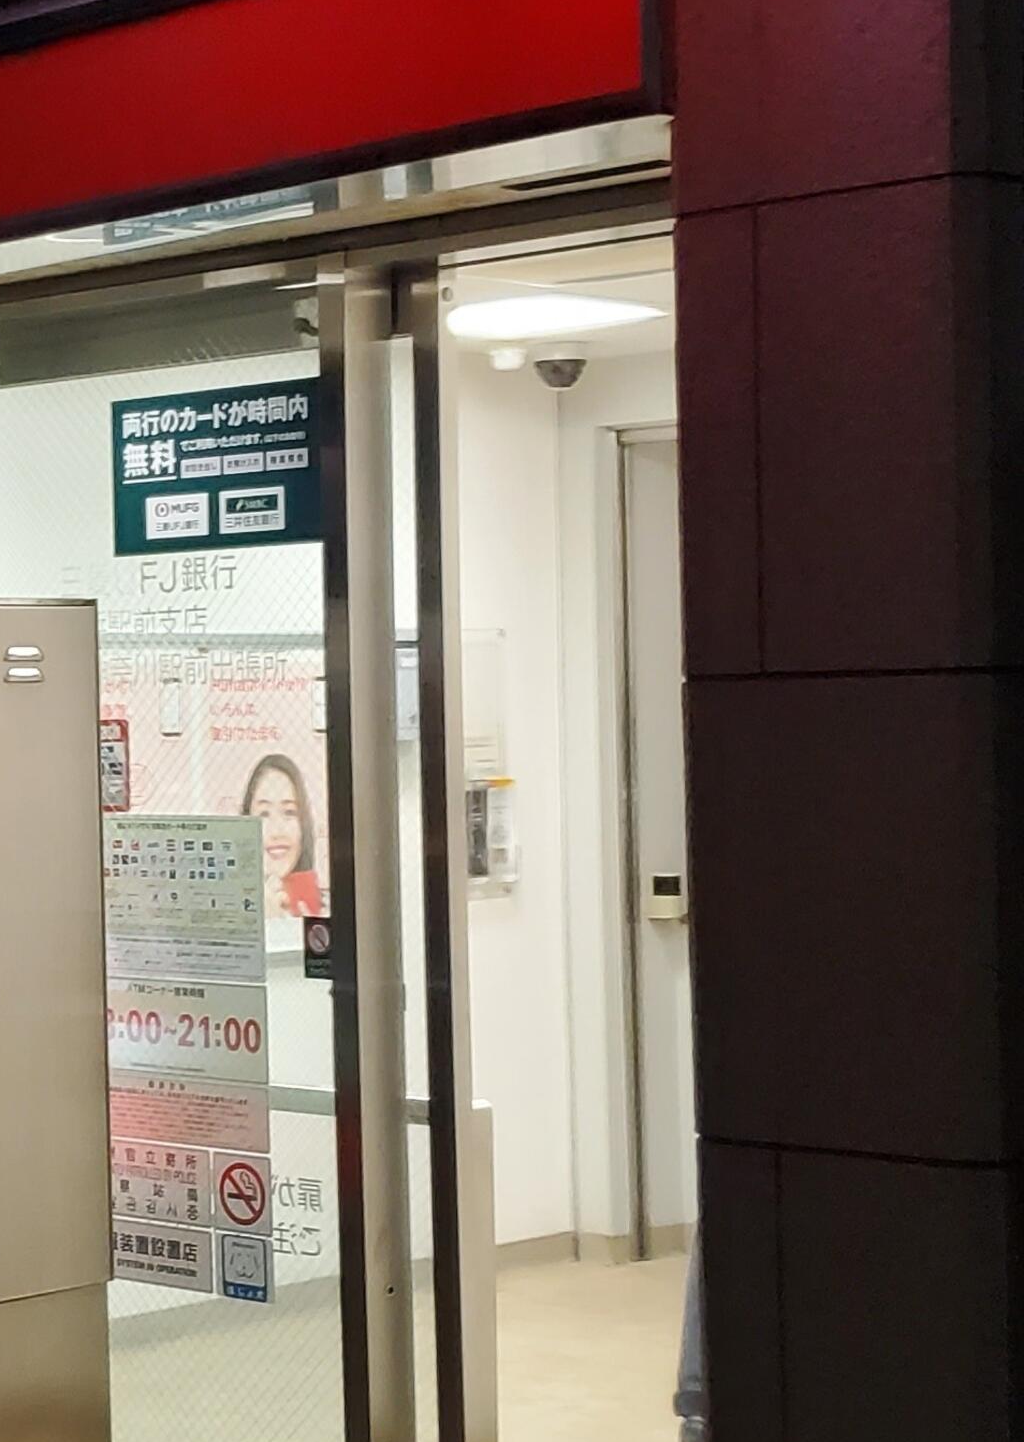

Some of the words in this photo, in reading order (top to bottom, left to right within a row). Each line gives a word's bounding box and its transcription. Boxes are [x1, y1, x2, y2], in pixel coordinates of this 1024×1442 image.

[121, 394, 309, 439] 両行のカードが時間内
[123, 439, 177, 477] 無料
[171, 502, 200, 514] MUFG
